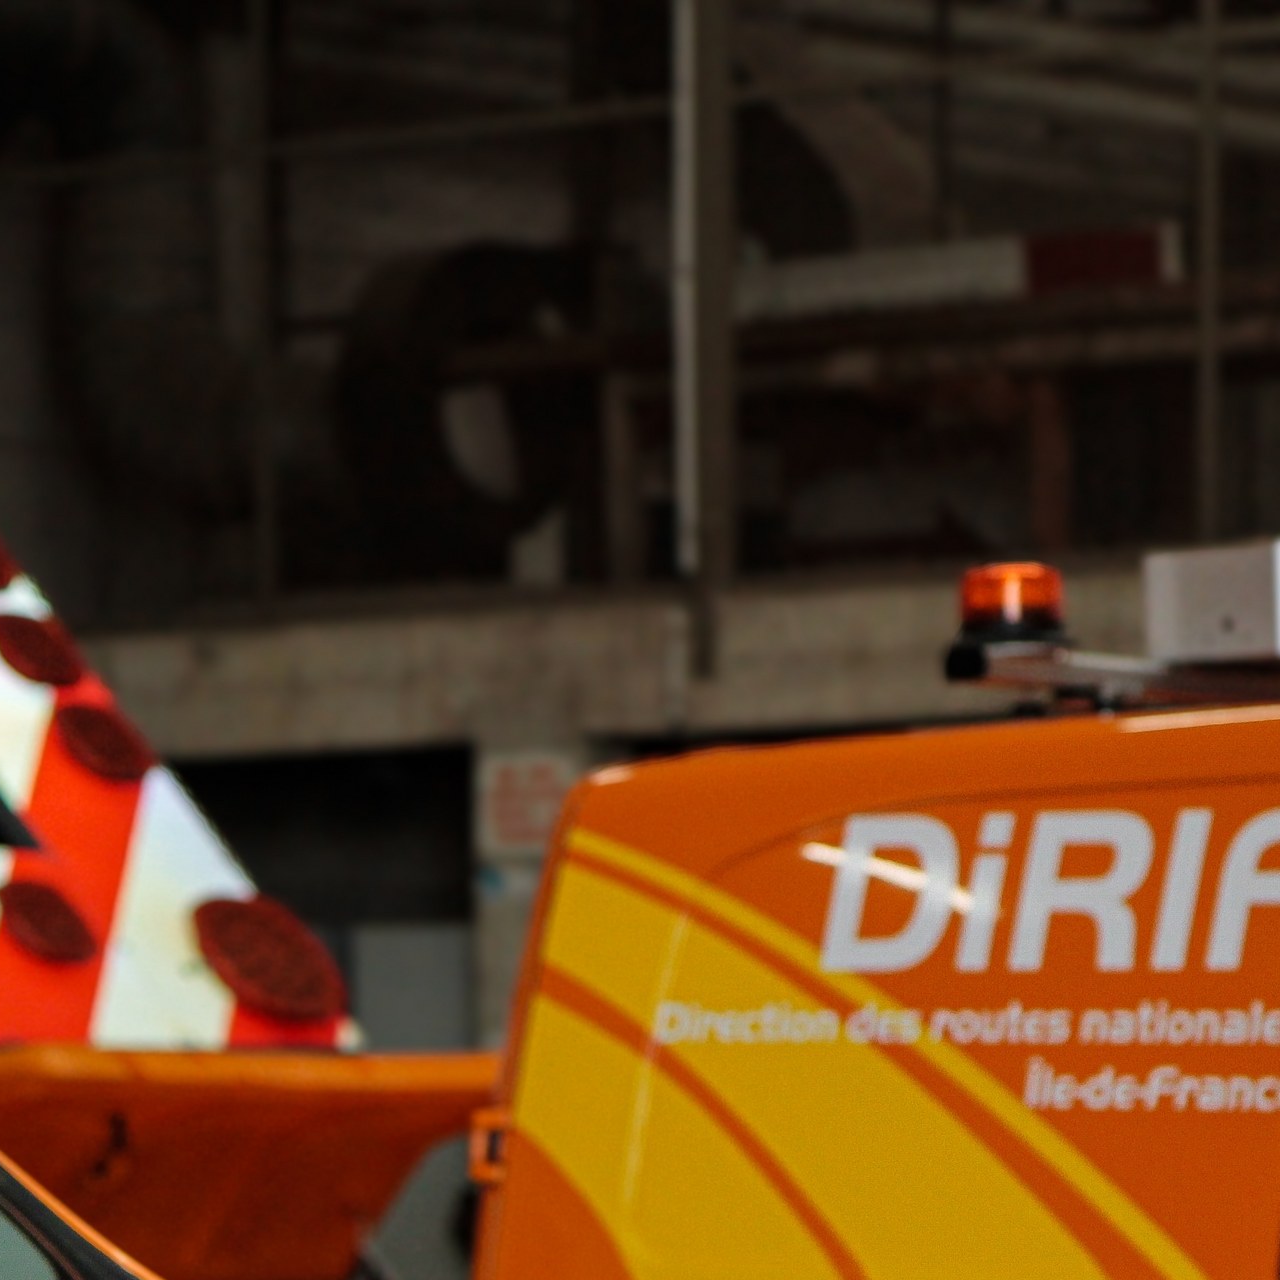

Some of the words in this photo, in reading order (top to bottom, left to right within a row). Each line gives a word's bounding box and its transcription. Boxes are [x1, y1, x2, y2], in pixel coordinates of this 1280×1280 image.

[656, 999, 839, 1043] Direction
[844, 998, 920, 1044] des
[929, 1000, 1071, 1045] routes
